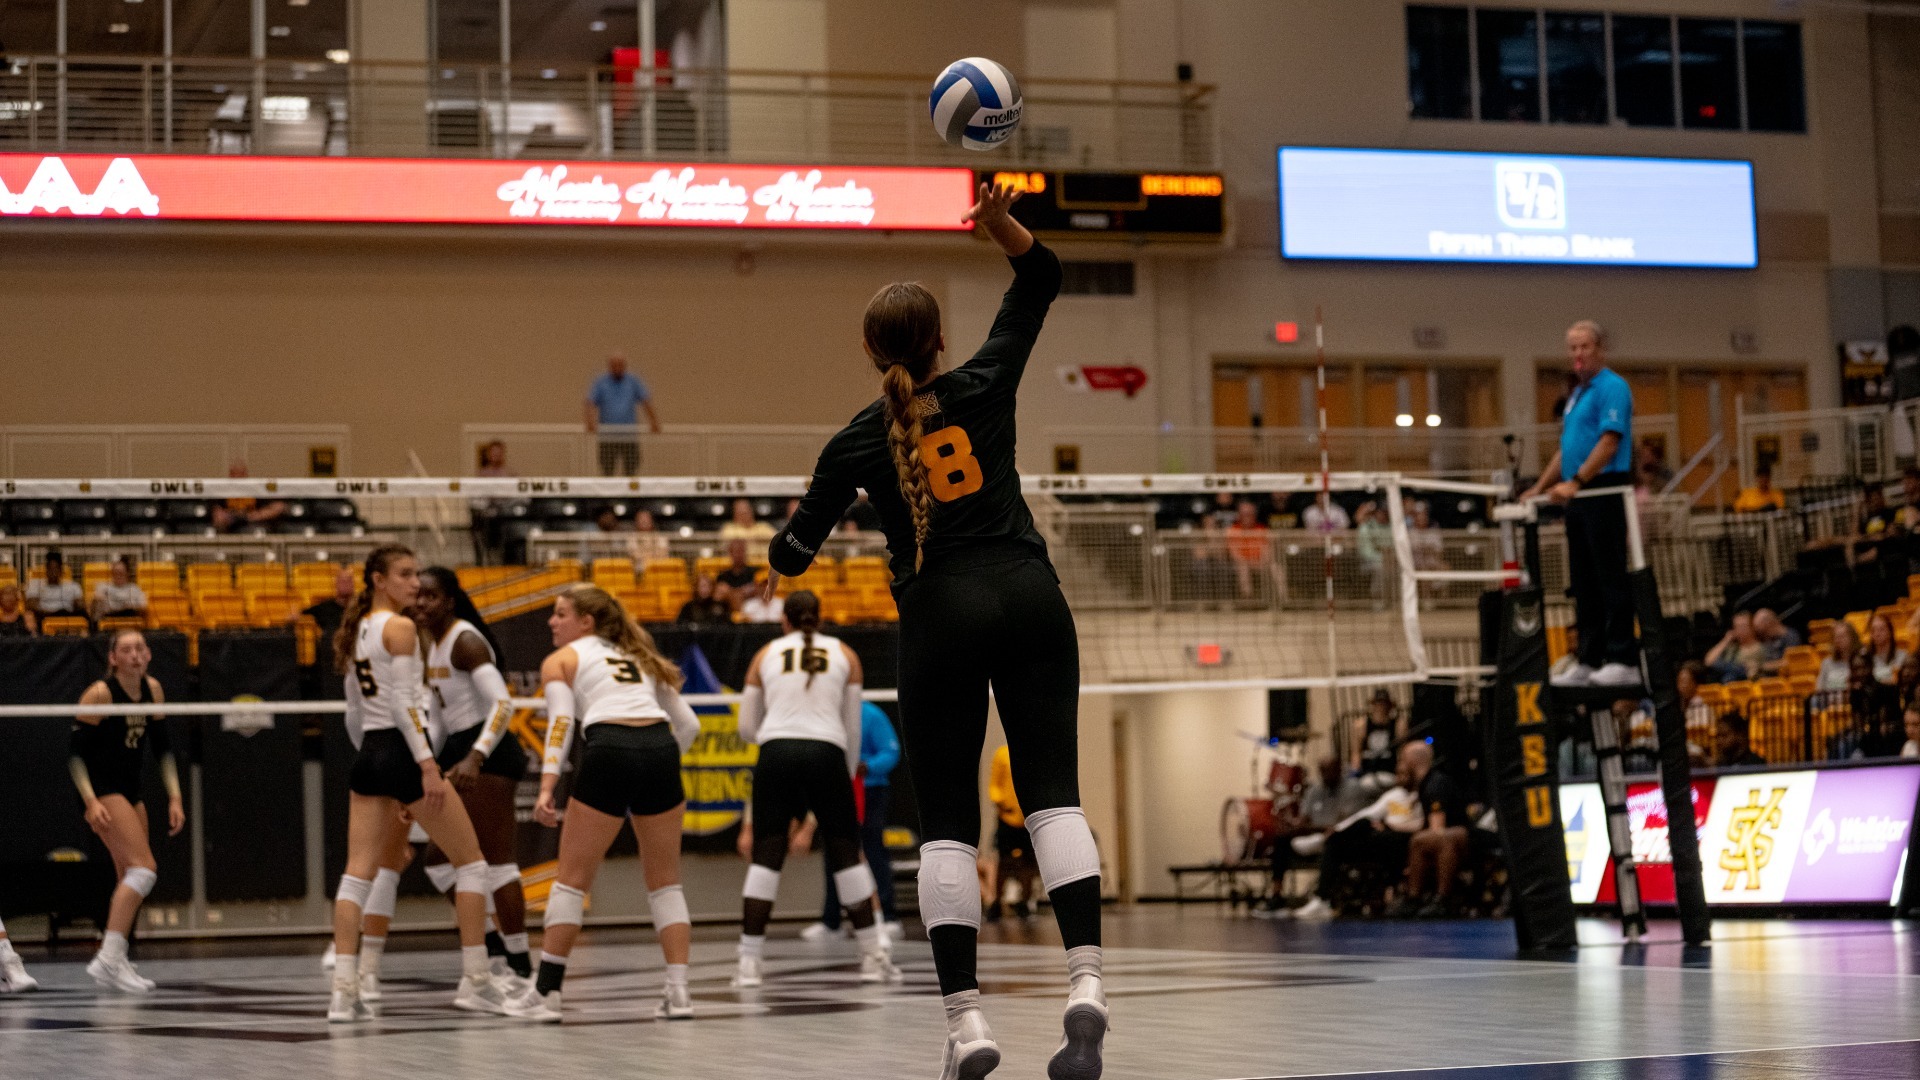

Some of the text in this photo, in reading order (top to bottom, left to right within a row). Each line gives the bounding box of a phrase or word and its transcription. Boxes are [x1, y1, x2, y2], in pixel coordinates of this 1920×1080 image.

[920, 425, 984, 502] 8
[151, 482, 204, 494] OWLS
[336, 482, 389, 493] OWLS
[518, 482, 570, 493] OWLS
[696, 481, 746, 491] OWLS
[1039, 476, 1087, 489] OWLS
[1204, 477, 1250, 488] OWLS
[605, 657, 643, 684] 3
